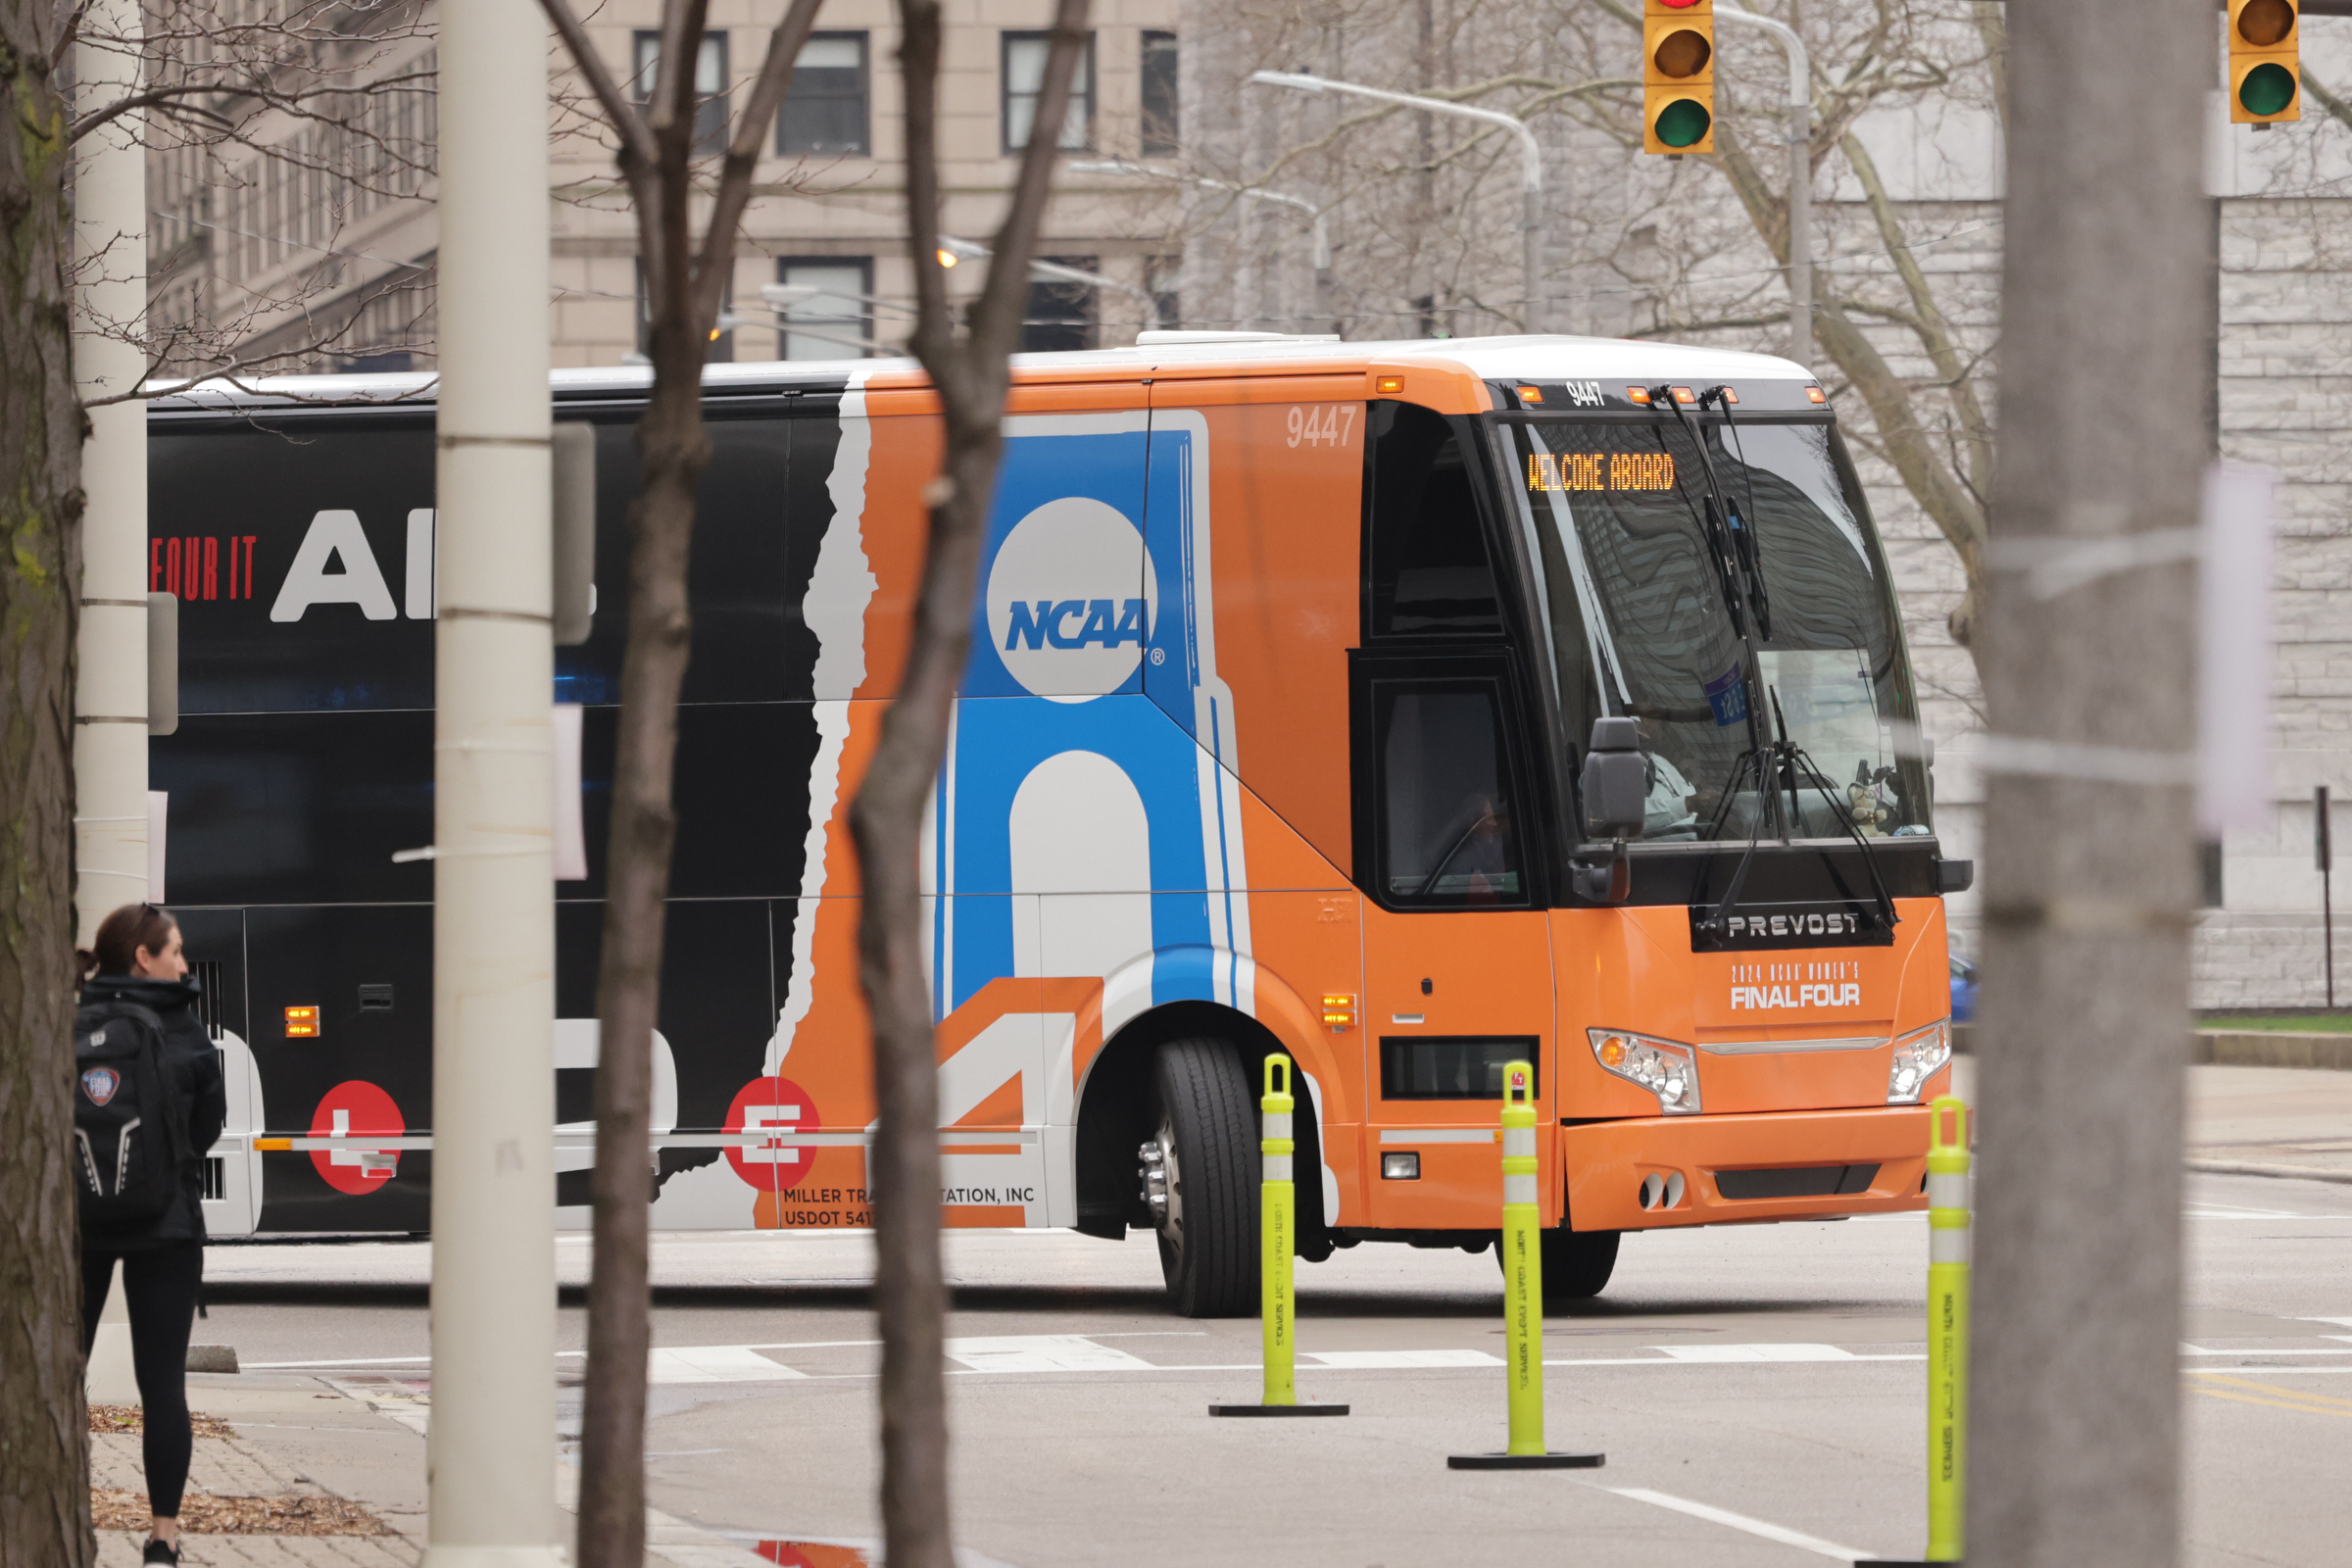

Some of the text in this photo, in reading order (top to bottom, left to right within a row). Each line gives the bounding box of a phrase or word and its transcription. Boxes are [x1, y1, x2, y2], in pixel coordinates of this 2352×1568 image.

[1566, 380, 1605, 407] 9447
[1286, 405, 1357, 449] 9447
[1529, 453, 1675, 491] WELCOME ABOARD
[229, 536, 257, 600] IT
[1004, 599, 1150, 651] NCAA
[1728, 912, 1859, 938] PREVOST
[1732, 964, 1761, 983] 2024
[1731, 982, 1860, 1009] FINAL FOUR
[784, 1187, 1035, 1204] MILLER TRTATION, INC
[785, 1210, 840, 1226] USDOT
[1516, 1230, 1526, 1263] NORT
